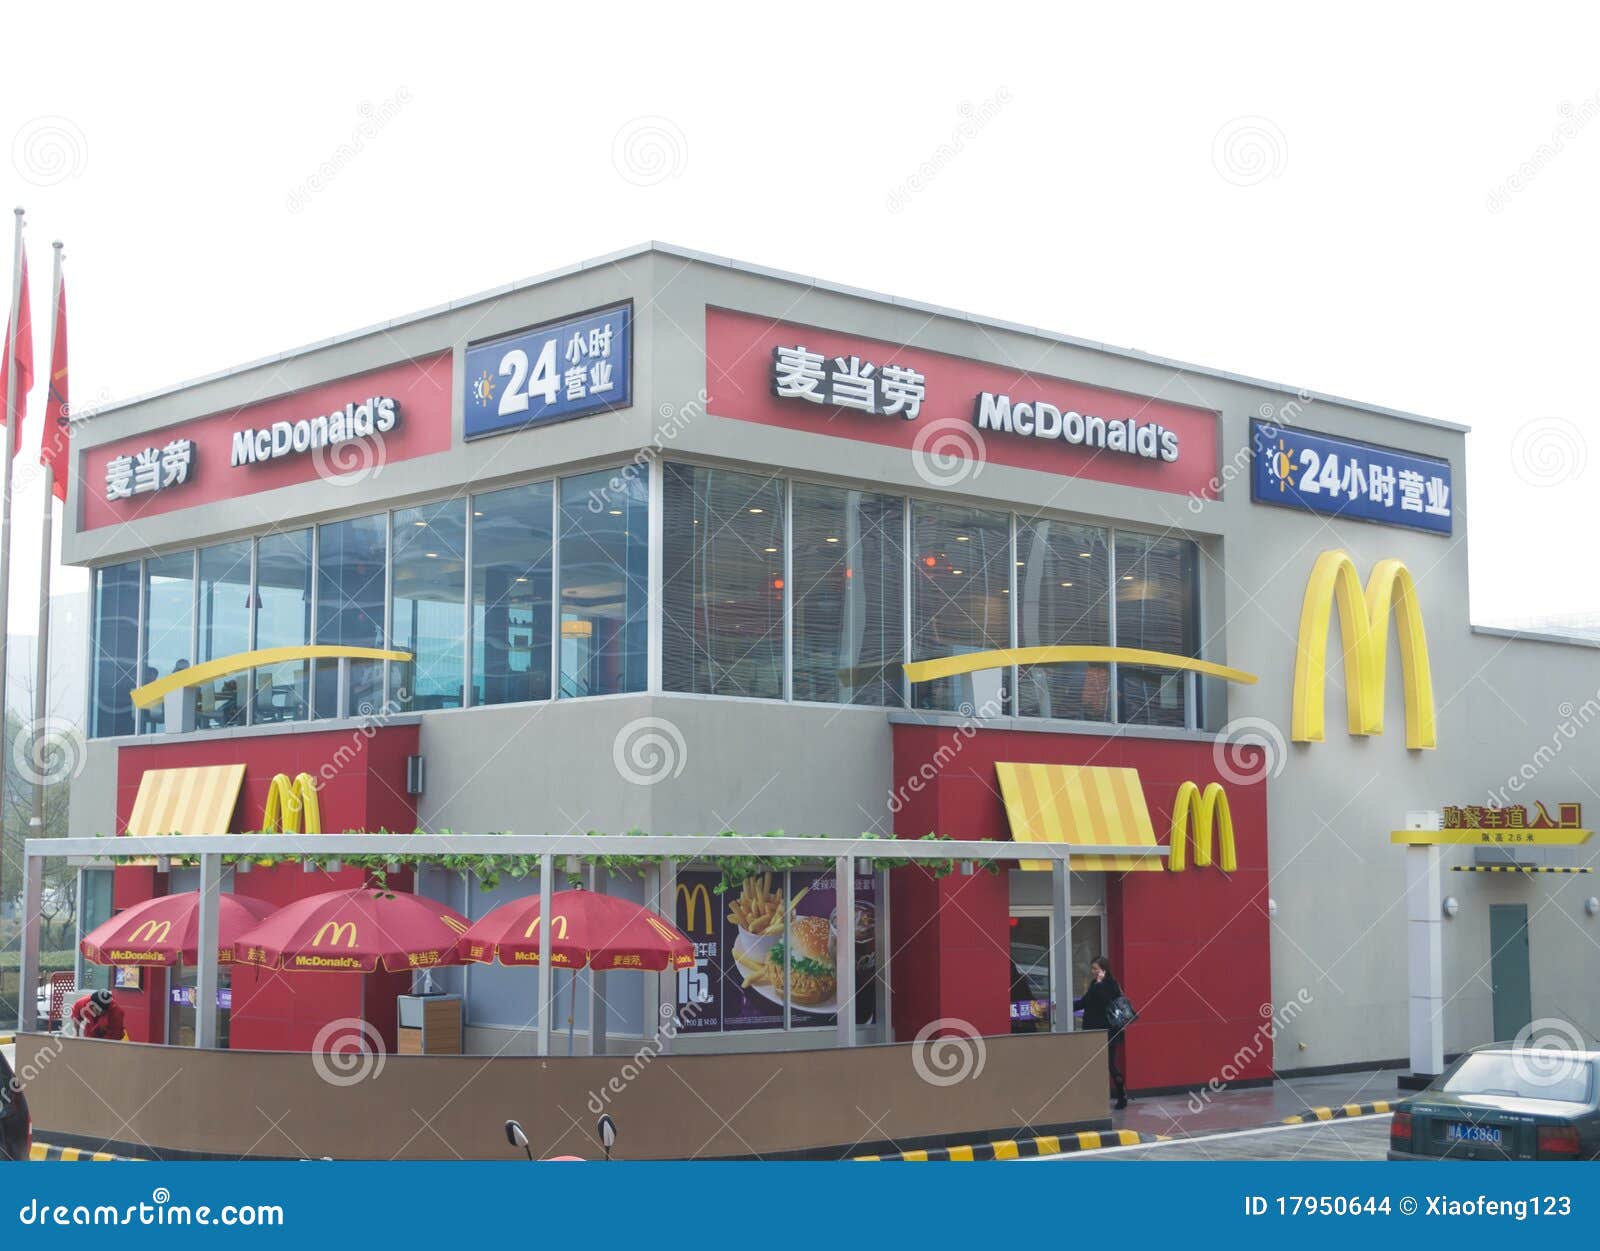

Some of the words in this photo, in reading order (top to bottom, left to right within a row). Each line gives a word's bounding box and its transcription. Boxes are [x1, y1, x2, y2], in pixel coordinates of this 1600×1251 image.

[498, 339, 558, 417] 24
[565, 323, 612, 367] 小时
[565, 360, 614, 400] 营业
[775, 345, 925, 420] 麦当劳
[977, 391, 1179, 463] McDonald's
[105, 439, 192, 500] 麦当劳
[231, 396, 396, 467] McDonald's
[1299, 447, 1451, 516] 24小时营业
[111, 951, 162, 961] McDonald's
[296, 955, 360, 968] McDonald's
